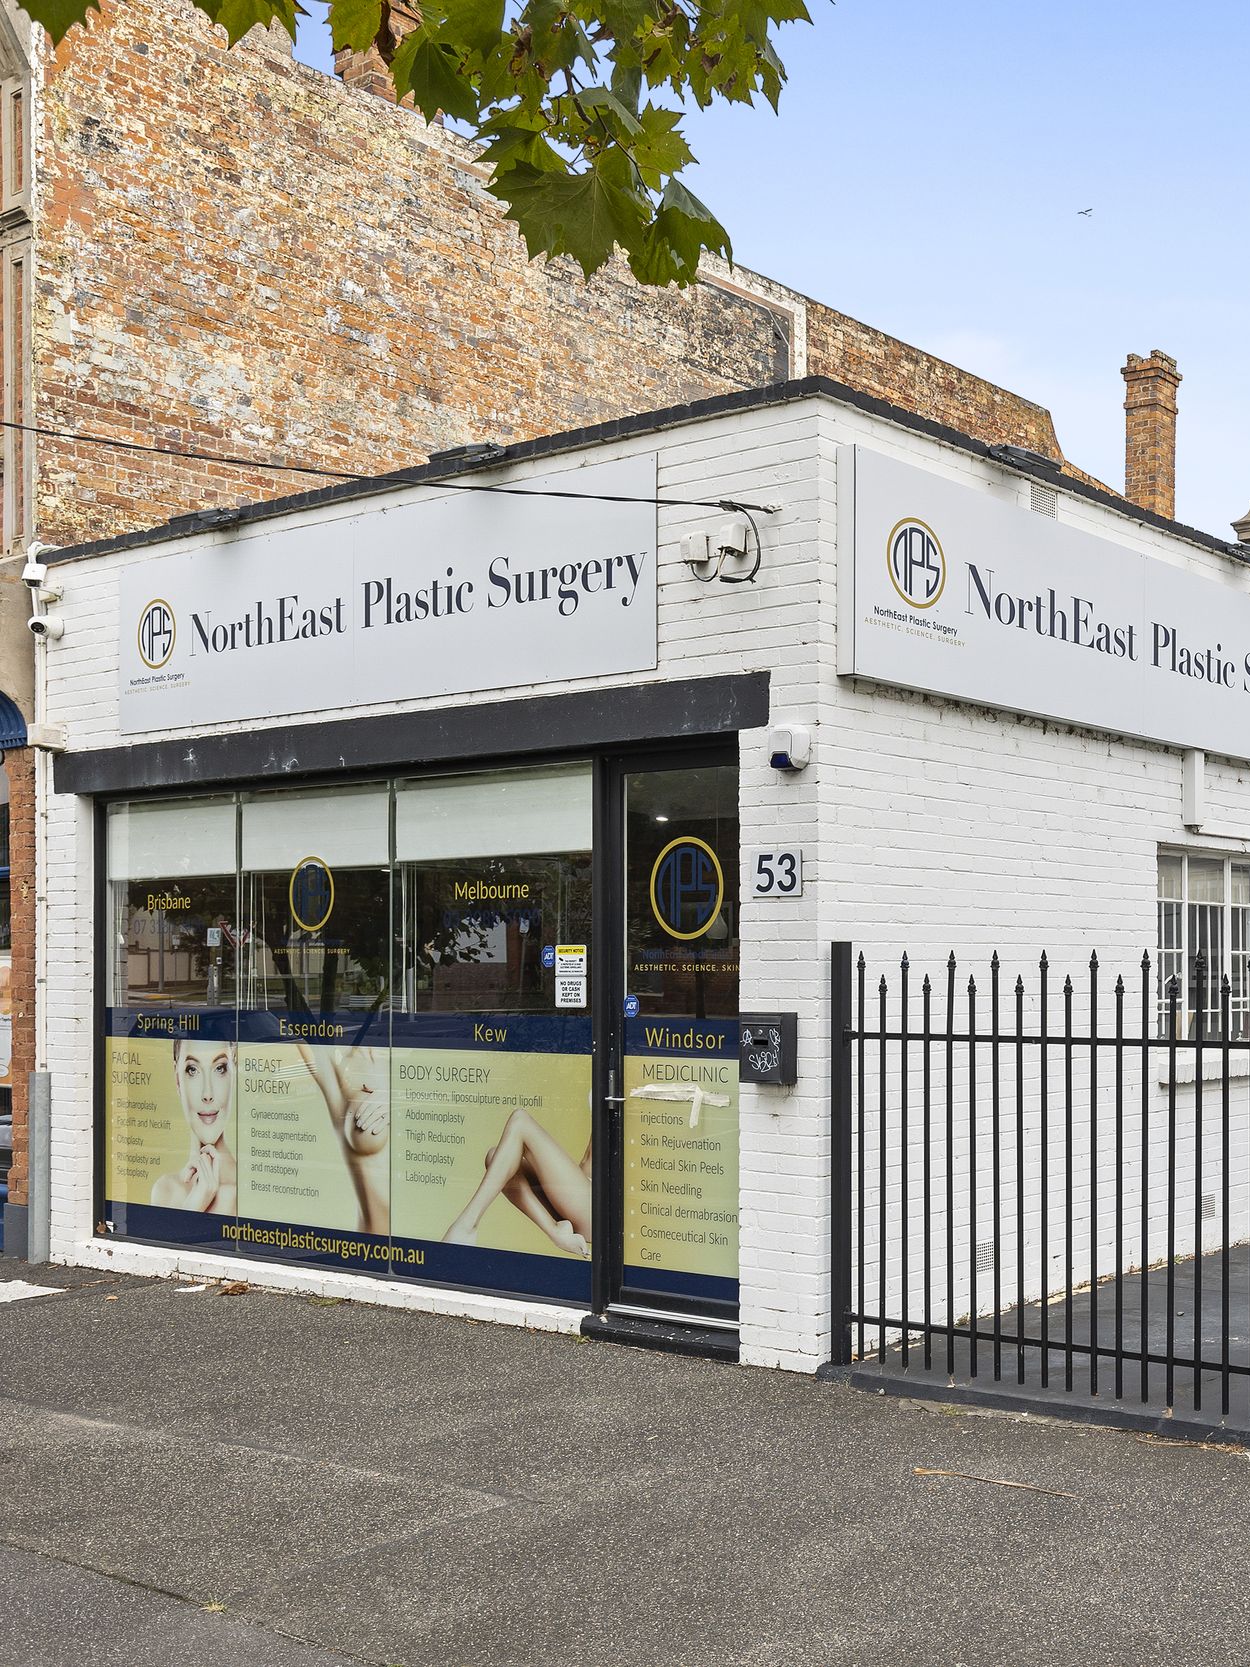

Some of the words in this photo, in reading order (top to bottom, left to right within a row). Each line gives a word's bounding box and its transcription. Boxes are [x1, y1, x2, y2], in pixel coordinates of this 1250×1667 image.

[189, 595, 347, 657] NorthEast
[361, 567, 474, 630] Plastic
[487, 551, 647, 616] Surgery
[873, 605, 908, 622] NorthEast
[909, 614, 931, 629] Plastic
[932, 620, 958, 637] Surgery
[964, 561, 1138, 662] NorthEast
[1150, 621, 1236, 689] Plastic
[937, 635, 966, 648] SURGERY
[167, 672, 185, 682] Surgery
[755, 852, 797, 893] 53
[454, 881, 529, 900] Melbourne
[147, 894, 191, 911] Brisbane
[634, 963, 679, 972] AESTHETIC.
[682, 963, 719, 972] SCIENCE.
[626, 1002, 637, 1010] ADT
[137, 1013, 174, 1032] Spring
[179, 1013, 200, 1031] Hill
[279, 1018, 343, 1037] Essendon
[474, 1023, 508, 1042] Kew
[645, 1027, 725, 1049] Windsor
[112, 1051, 141, 1065] FACIAL
[244, 1058, 282, 1072] BREAST
[112, 1070, 152, 1086] SURGERY
[399, 1065, 432, 1081] BODY
[435, 1066, 490, 1084] SURGERY
[642, 1064, 729, 1083] MEDICLINIC
[244, 1079, 291, 1095] SURGERY
[451, 1091, 500, 1105] liposculpture
[502, 1093, 517, 1106] and
[519, 1094, 543, 1109] lipofill
[137, 1118, 148, 1128] and
[251, 1108, 299, 1122] Gynaecomastia
[405, 1109, 465, 1125] Abdominoplasty
[640, 1111, 684, 1125] injections
[251, 1127, 271, 1140] Breast
[272, 1130, 317, 1143] augmentation
[405, 1129, 426, 1143] Thigh
[428, 1130, 466, 1145] Reduction
[640, 1133, 659, 1147] Skin
[662, 1135, 721, 1152] Rejuvenation
[149, 1156, 161, 1166] and
[251, 1146, 271, 1158] Breast
[272, 1148, 304, 1161] reduction
[405, 1149, 455, 1166] Brachioplasty
[251, 1161, 263, 1172] and
[264, 1164, 299, 1177] mastopexy
[640, 1157, 676, 1171] Medical
[678, 1159, 697, 1173] Skin
[700, 1161, 724, 1175] Peels
[405, 1170, 447, 1187] Labioplasty
[251, 1180, 271, 1192] Breast
[272, 1183, 319, 1198] reconstruction
[640, 1180, 659, 1194] Skin
[662, 1182, 702, 1199] Needling
[640, 1202, 673, 1217] Clinical
[674, 1205, 738, 1224] dermabrasion
[222, 1223, 425, 1265] northeastplasticsurgery.com.au
[640, 1225, 706, 1244] Cosmeceutical
[709, 1231, 728, 1246] Skin
[640, 1248, 662, 1262] Care
